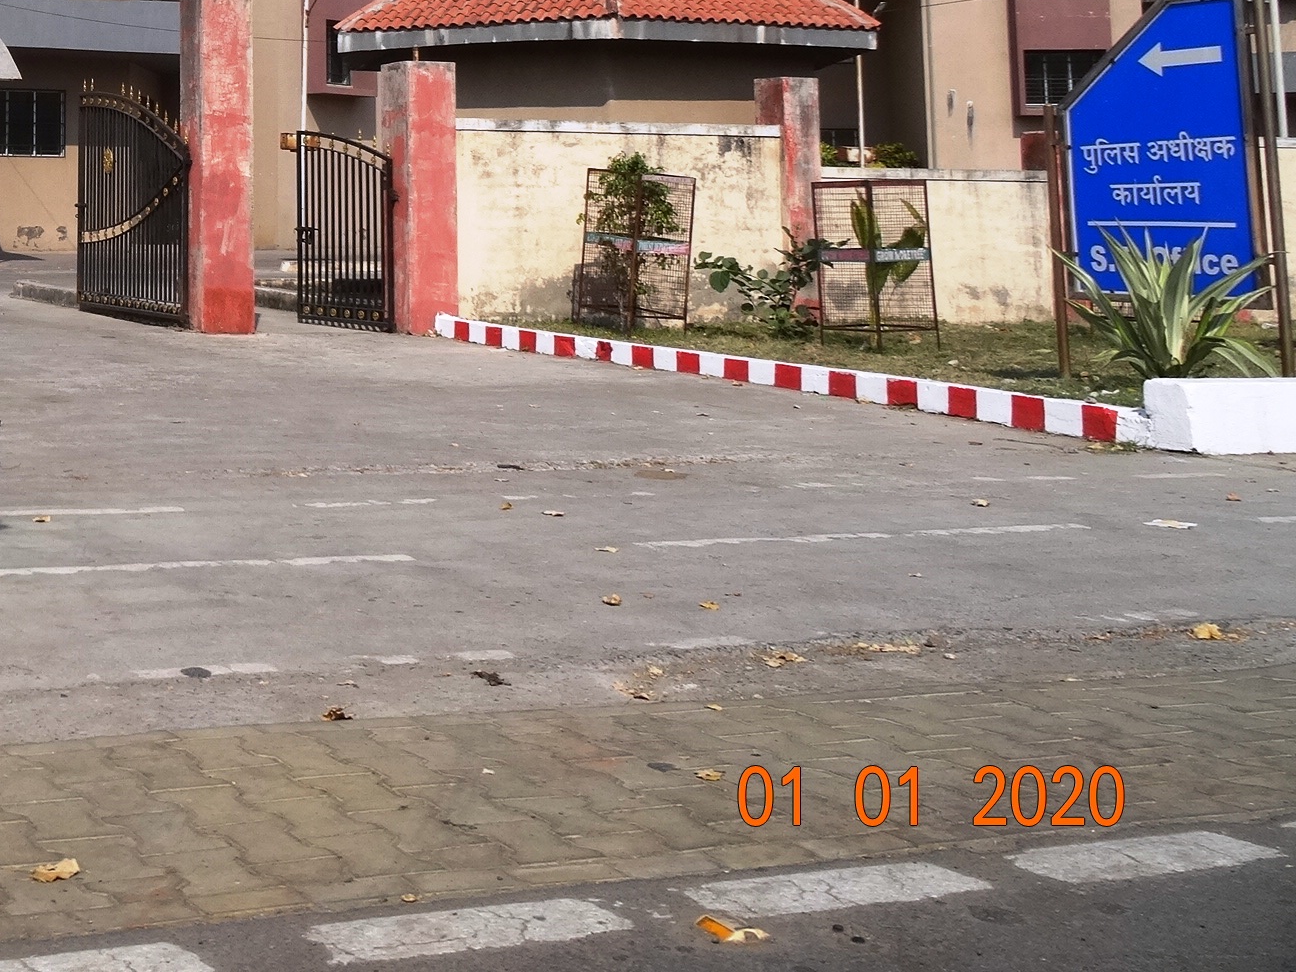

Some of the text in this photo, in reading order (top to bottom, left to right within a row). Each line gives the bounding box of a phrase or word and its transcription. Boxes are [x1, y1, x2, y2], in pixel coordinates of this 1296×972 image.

[1080, 131, 1236, 174] पुलिस अधीक्षक
[1109, 175, 1201, 206] कार्यालय
